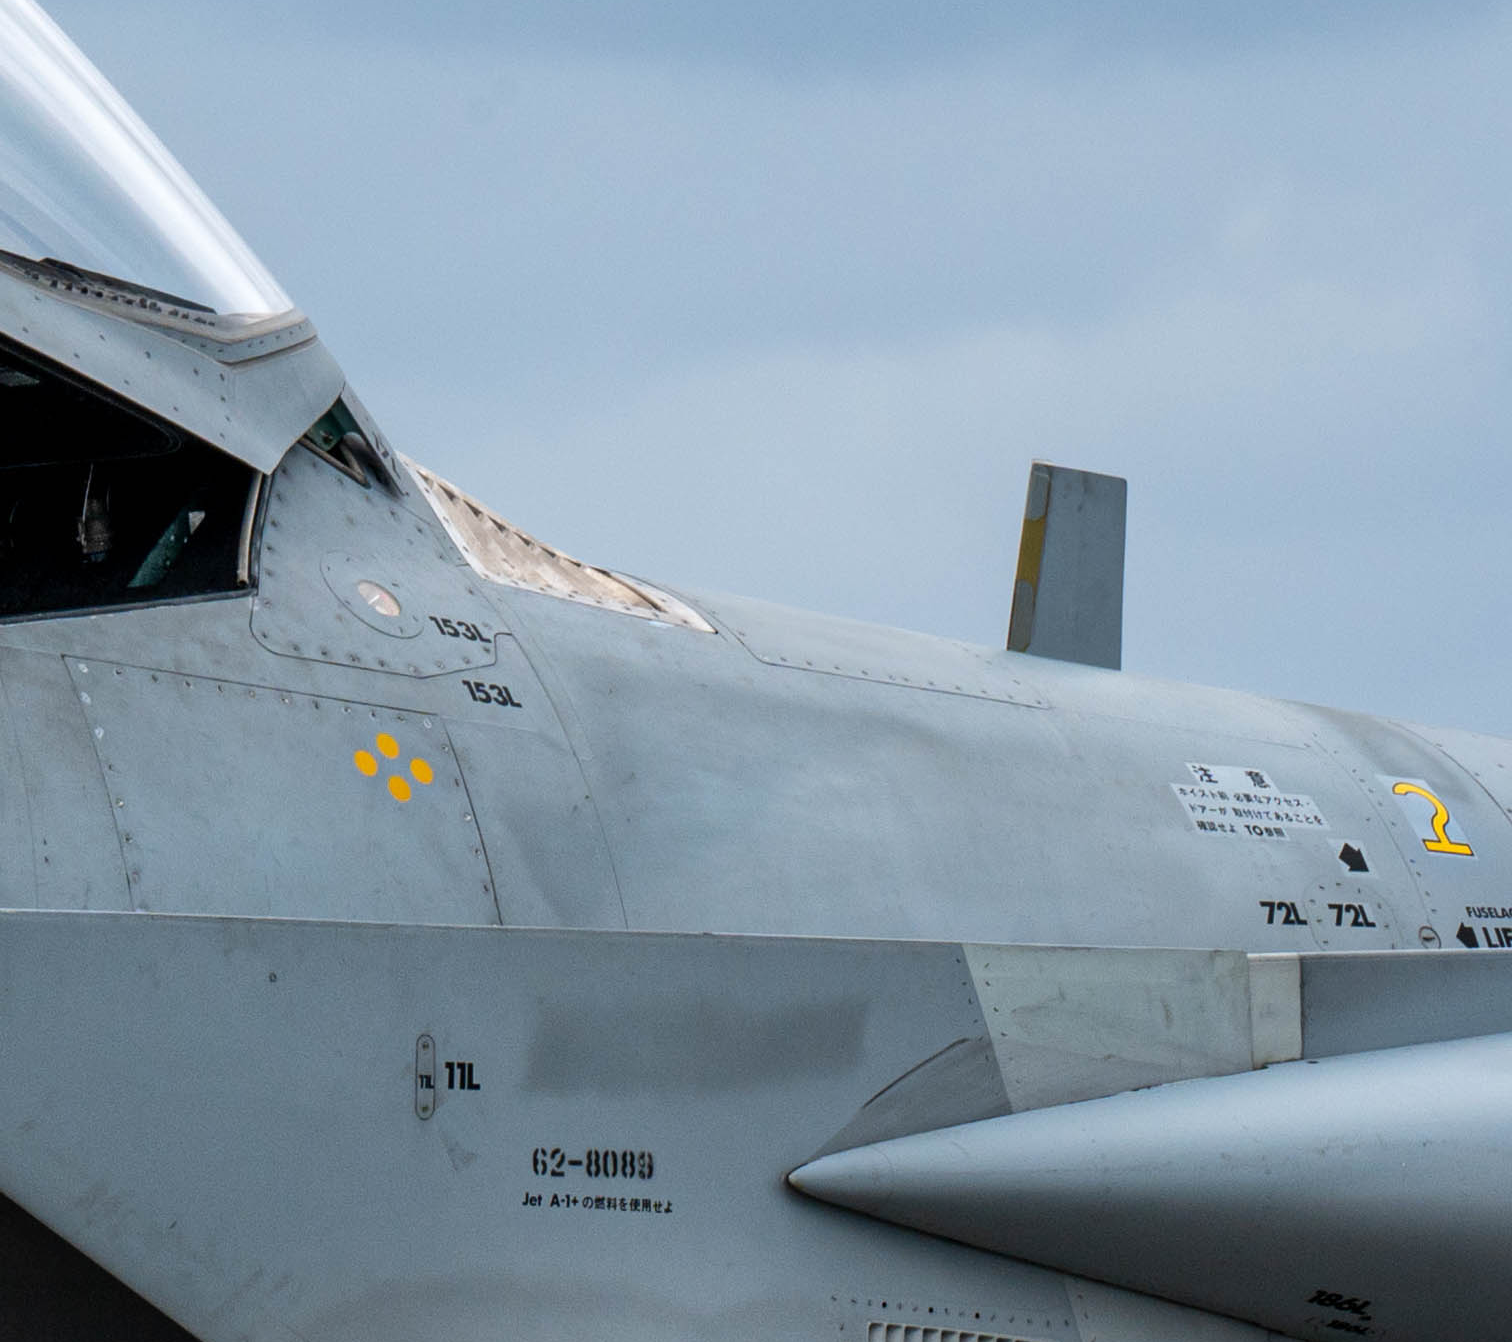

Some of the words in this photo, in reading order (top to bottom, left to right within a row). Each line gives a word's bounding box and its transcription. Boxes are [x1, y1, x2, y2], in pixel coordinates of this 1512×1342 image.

[428, 615, 492, 644] 153L
[462, 679, 523, 709] 153L
[1191, 765, 1271, 789] 注意
[1392, 781, 1475, 856] 2
[1259, 900, 1308, 926] 72L
[1328, 903, 1377, 928] 72L
[418, 1074, 435, 1089] 11L
[445, 1061, 481, 1091] 11L
[522, 1192, 543, 1207] Jet
